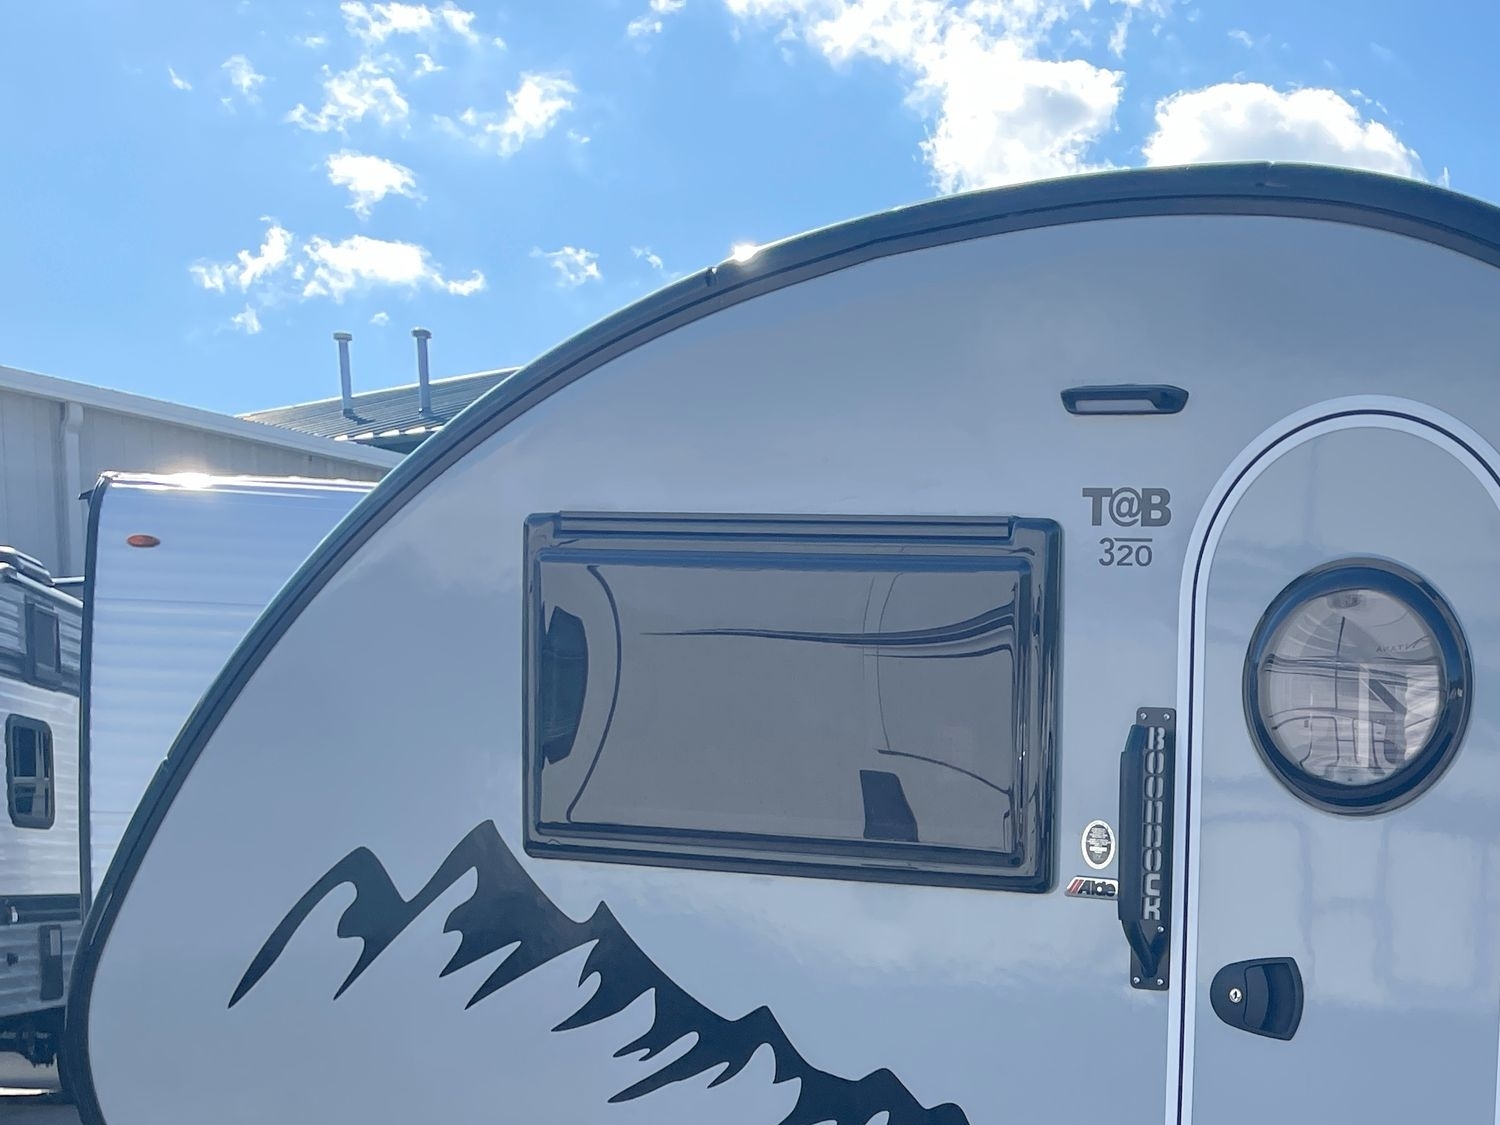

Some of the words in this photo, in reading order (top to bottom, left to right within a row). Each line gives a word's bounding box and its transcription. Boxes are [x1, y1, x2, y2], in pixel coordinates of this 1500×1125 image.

[1082, 487, 1172, 527] T@B
[1098, 537, 1153, 566] 320
[1143, 727, 1166, 920] BOONDOCK
[1078, 880, 1116, 896] Alde
